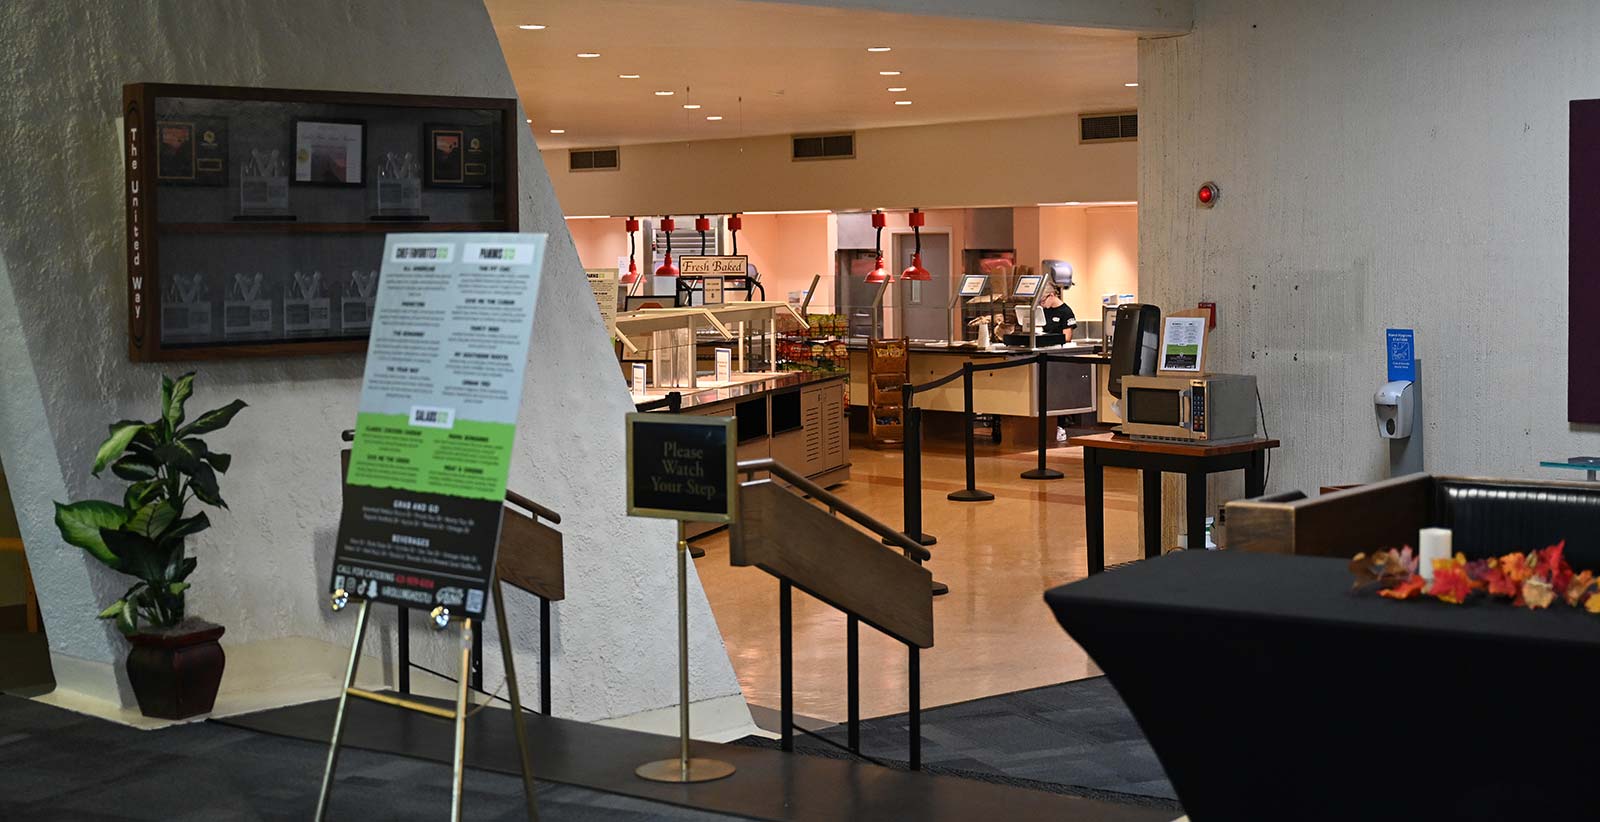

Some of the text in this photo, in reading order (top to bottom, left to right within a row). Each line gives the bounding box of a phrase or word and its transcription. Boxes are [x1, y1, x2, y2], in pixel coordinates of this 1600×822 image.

[131, 181, 140, 266] United
[682, 260, 744, 271] Fresh Baked
[132, 277, 143, 318] Way
[663, 441, 703, 459] Please
[662, 459, 704, 477] Watch
[651, 476, 716, 500] Your Step
[393, 500, 440, 513] GRAB AND GO
[392, 534, 430, 547] BEVERAGES
[337, 564, 351, 575] CALL
[352, 566, 364, 576] FOR
[365, 568, 395, 582] CATERING
